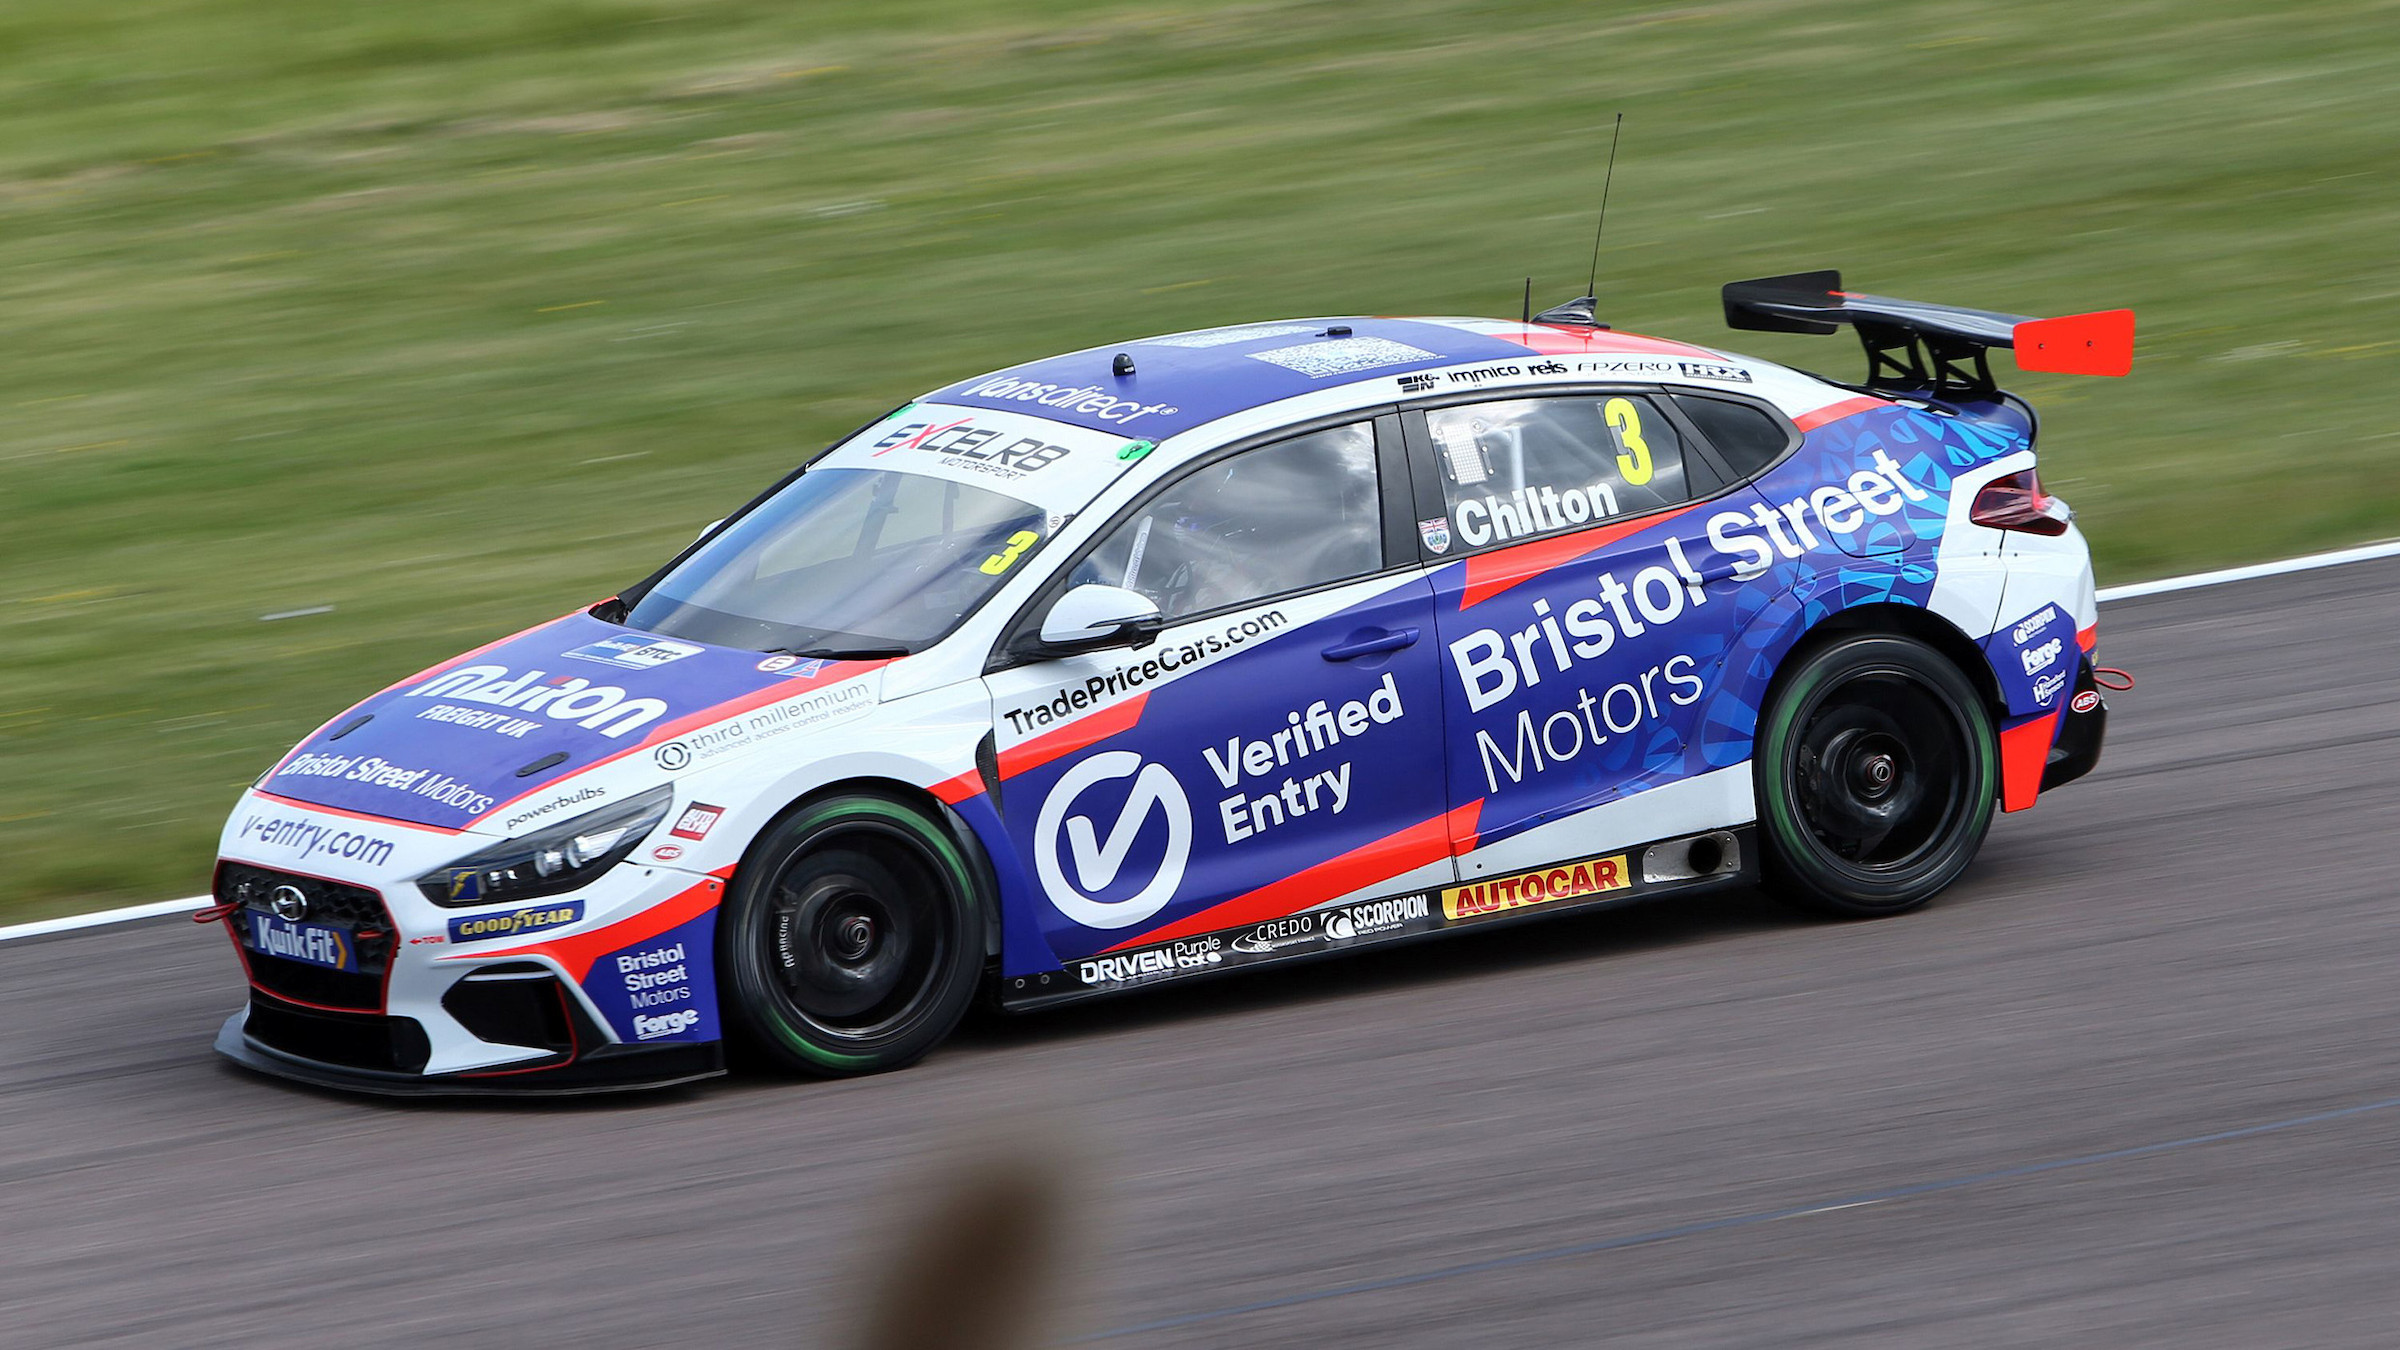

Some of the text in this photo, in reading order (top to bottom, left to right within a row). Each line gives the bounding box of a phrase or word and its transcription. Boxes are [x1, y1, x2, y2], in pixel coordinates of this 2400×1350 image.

[1527, 360, 1568, 376] reis
[871, 416, 1071, 472] EXCELR8
[1604, 396, 1654, 486] 3
[937, 456, 1028, 481] MOTORSPORT
[1455, 481, 1620, 547] Chilton
[978, 529, 1040, 576] 3
[1447, 448, 1932, 714] Bristol Street
[1003, 608, 1288, 735] TradePriceCars.com
[415, 704, 544, 739] FREIGHT UK
[690, 682, 870, 751] third millennium
[1202, 671, 1405, 790] Verified
[1474, 654, 1704, 795] Motors
[276, 753, 495, 815] Bristol Street Motors
[1218, 761, 1352, 845] Entry
[506, 786, 606, 831] powerbulbs
[239, 814, 395, 867] v-entry.com
[1455, 858, 1619, 917] AUTOCAR
[1256, 916, 1313, 942] CREDO
[1353, 894, 1430, 930] SCORPION
[616, 942, 686, 974] Bristol
[1079, 947, 1176, 984] DRIVEN
[1174, 935, 1222, 957] Purple
[1176, 954, 1209, 969] Dot
[624, 964, 689, 992] Street
[629, 986, 692, 1010] Motors
